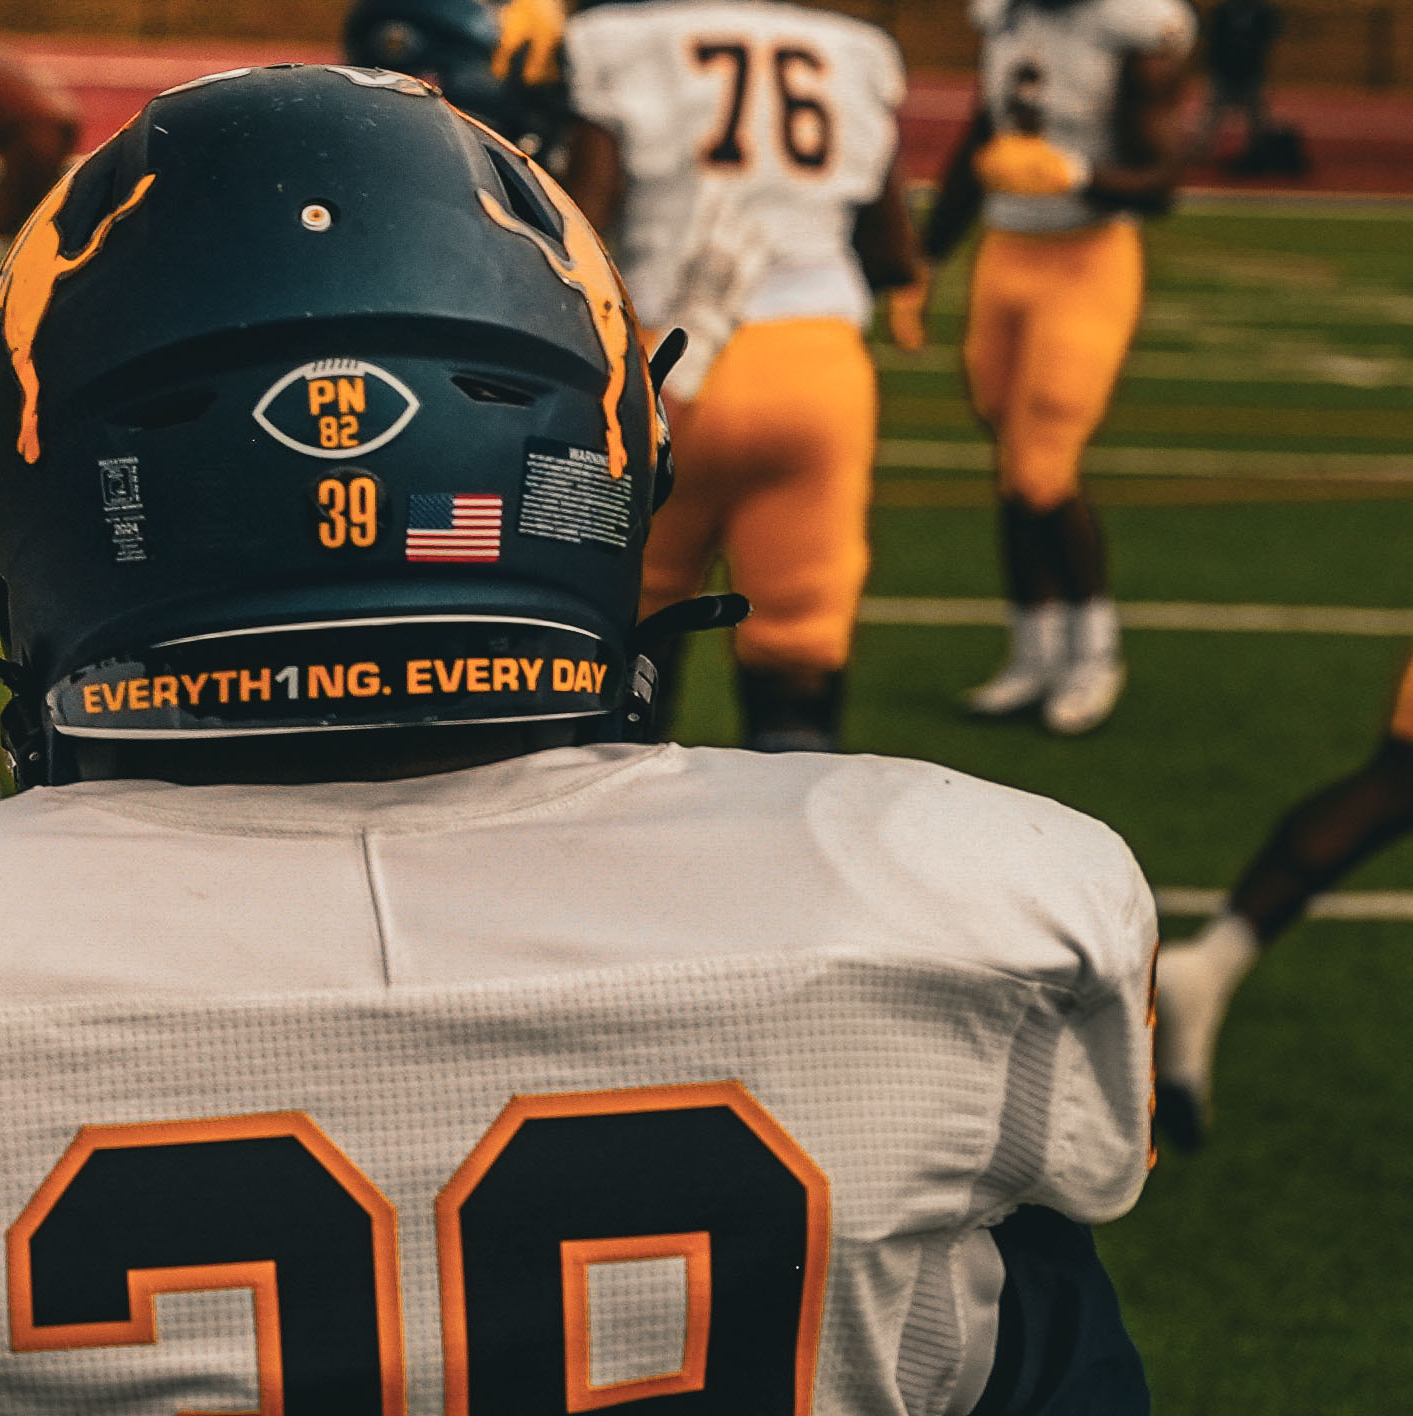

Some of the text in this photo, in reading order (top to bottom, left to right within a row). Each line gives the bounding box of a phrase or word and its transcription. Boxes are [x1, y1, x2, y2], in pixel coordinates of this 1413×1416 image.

[687, 32, 837, 178] 76
[308, 377, 366, 416] PN
[319, 415, 361, 448] 82
[318, 476, 377, 548] 39
[83, 657, 608, 714] EVERYTH1NG. EVERY DAY
